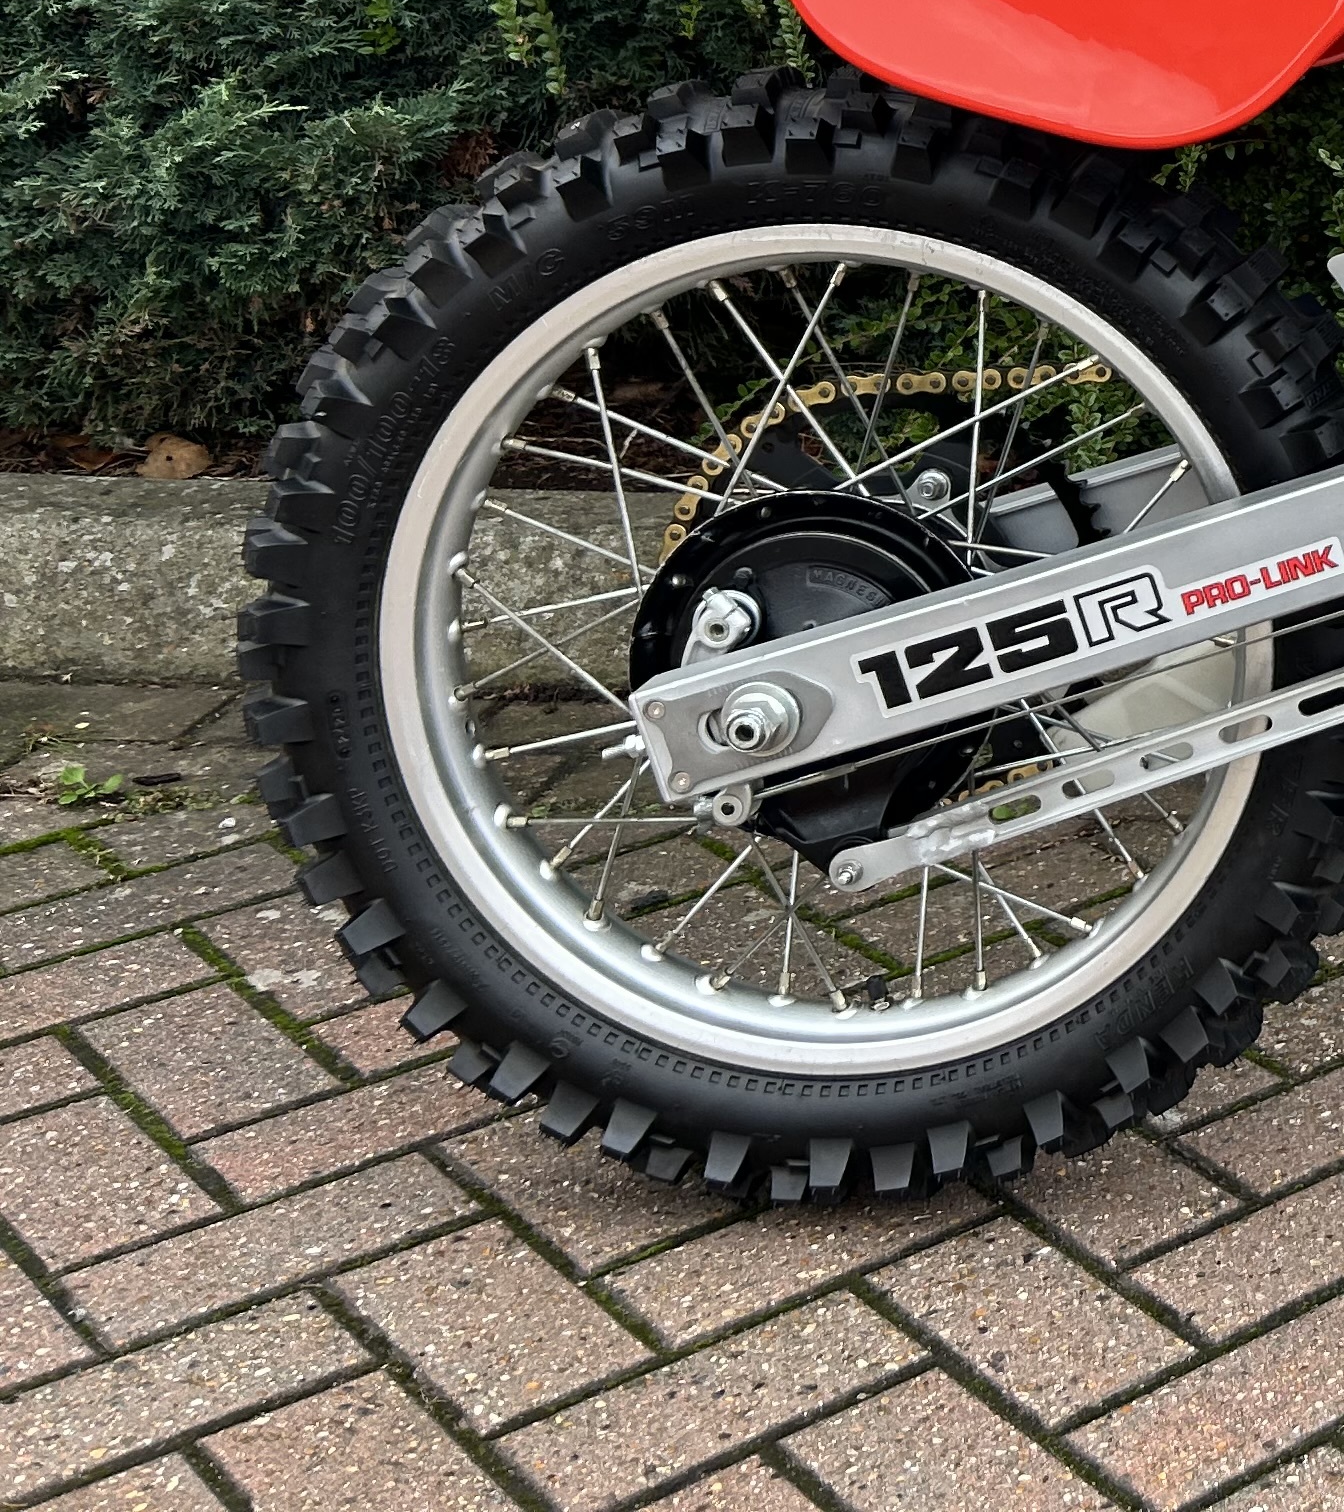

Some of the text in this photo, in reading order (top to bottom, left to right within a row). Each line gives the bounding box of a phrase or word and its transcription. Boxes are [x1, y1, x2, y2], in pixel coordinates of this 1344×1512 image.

[747, 179, 881, 206] K-760
[1180, 544, 1340, 616] PRO-LINK
[858, 571, 1174, 709] 125R
